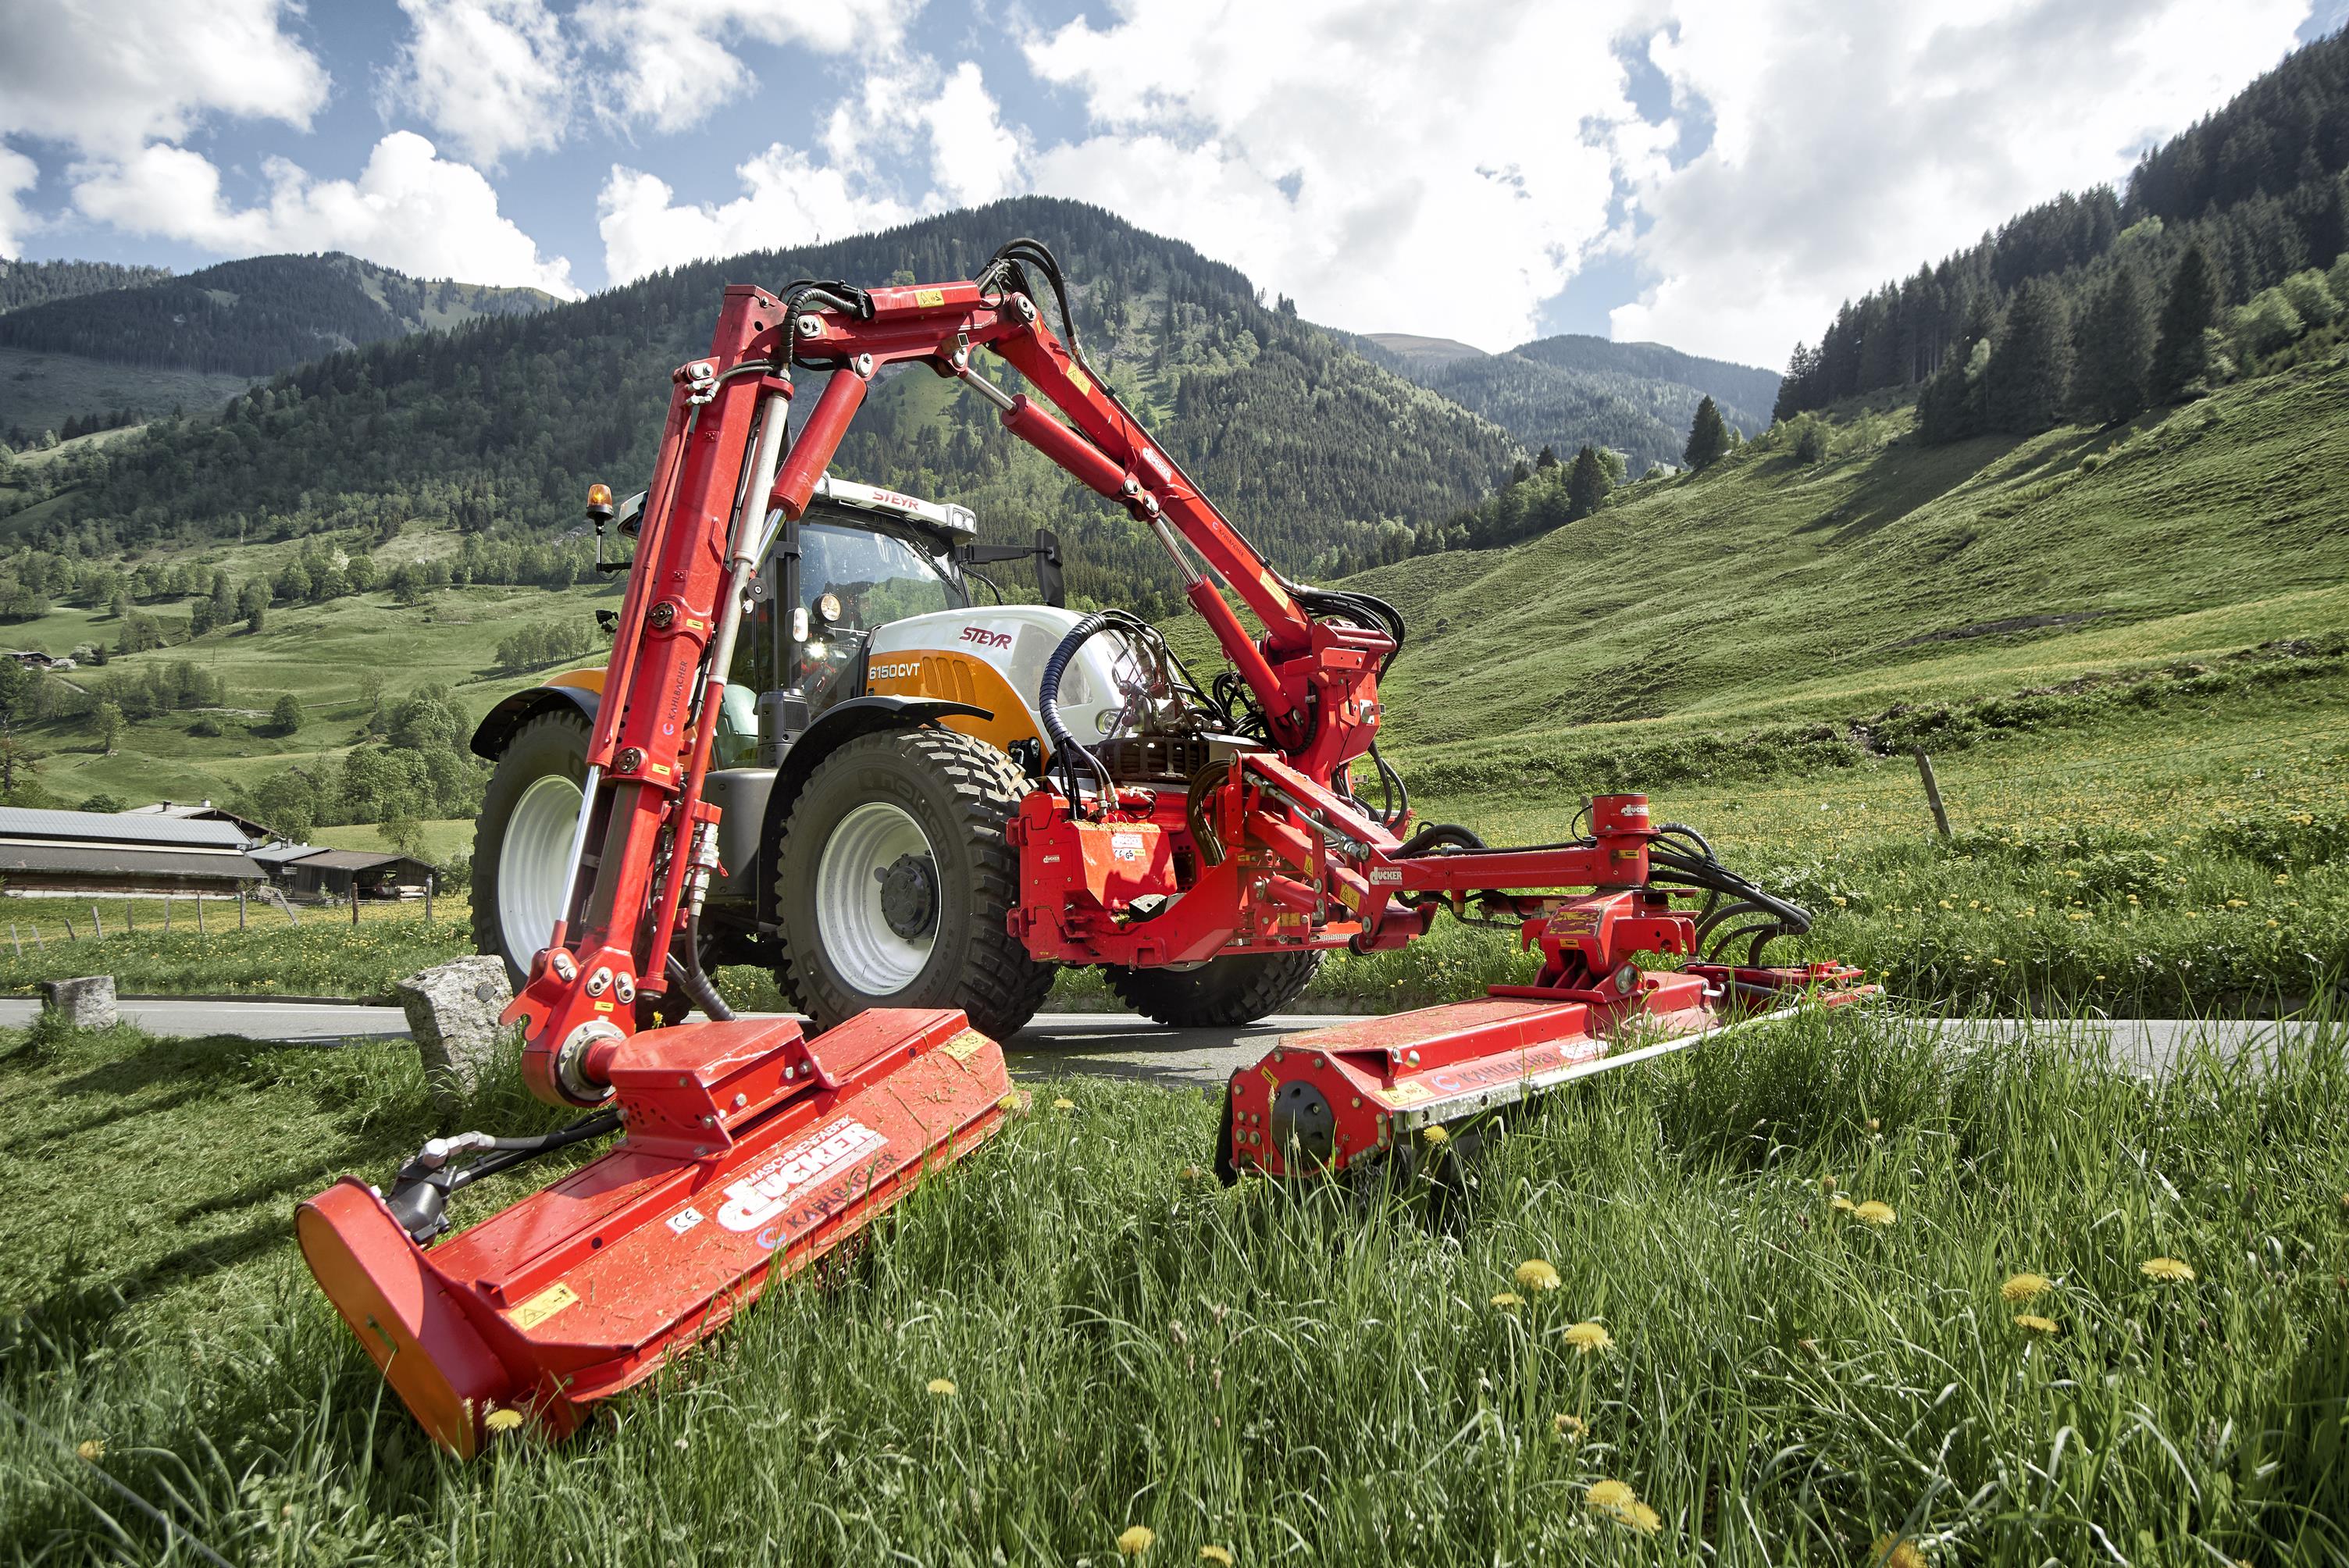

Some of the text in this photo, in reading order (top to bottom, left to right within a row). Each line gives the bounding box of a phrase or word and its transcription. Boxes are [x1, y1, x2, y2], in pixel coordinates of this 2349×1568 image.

[872, 490, 919, 511] STEYR
[959, 626, 1012, 650] STEYR
[668, 661, 688, 720] KAHLBACHER
[745, 1114, 857, 1185] MASCHINENFABRIK
[674, 1210, 700, 1228] CE
